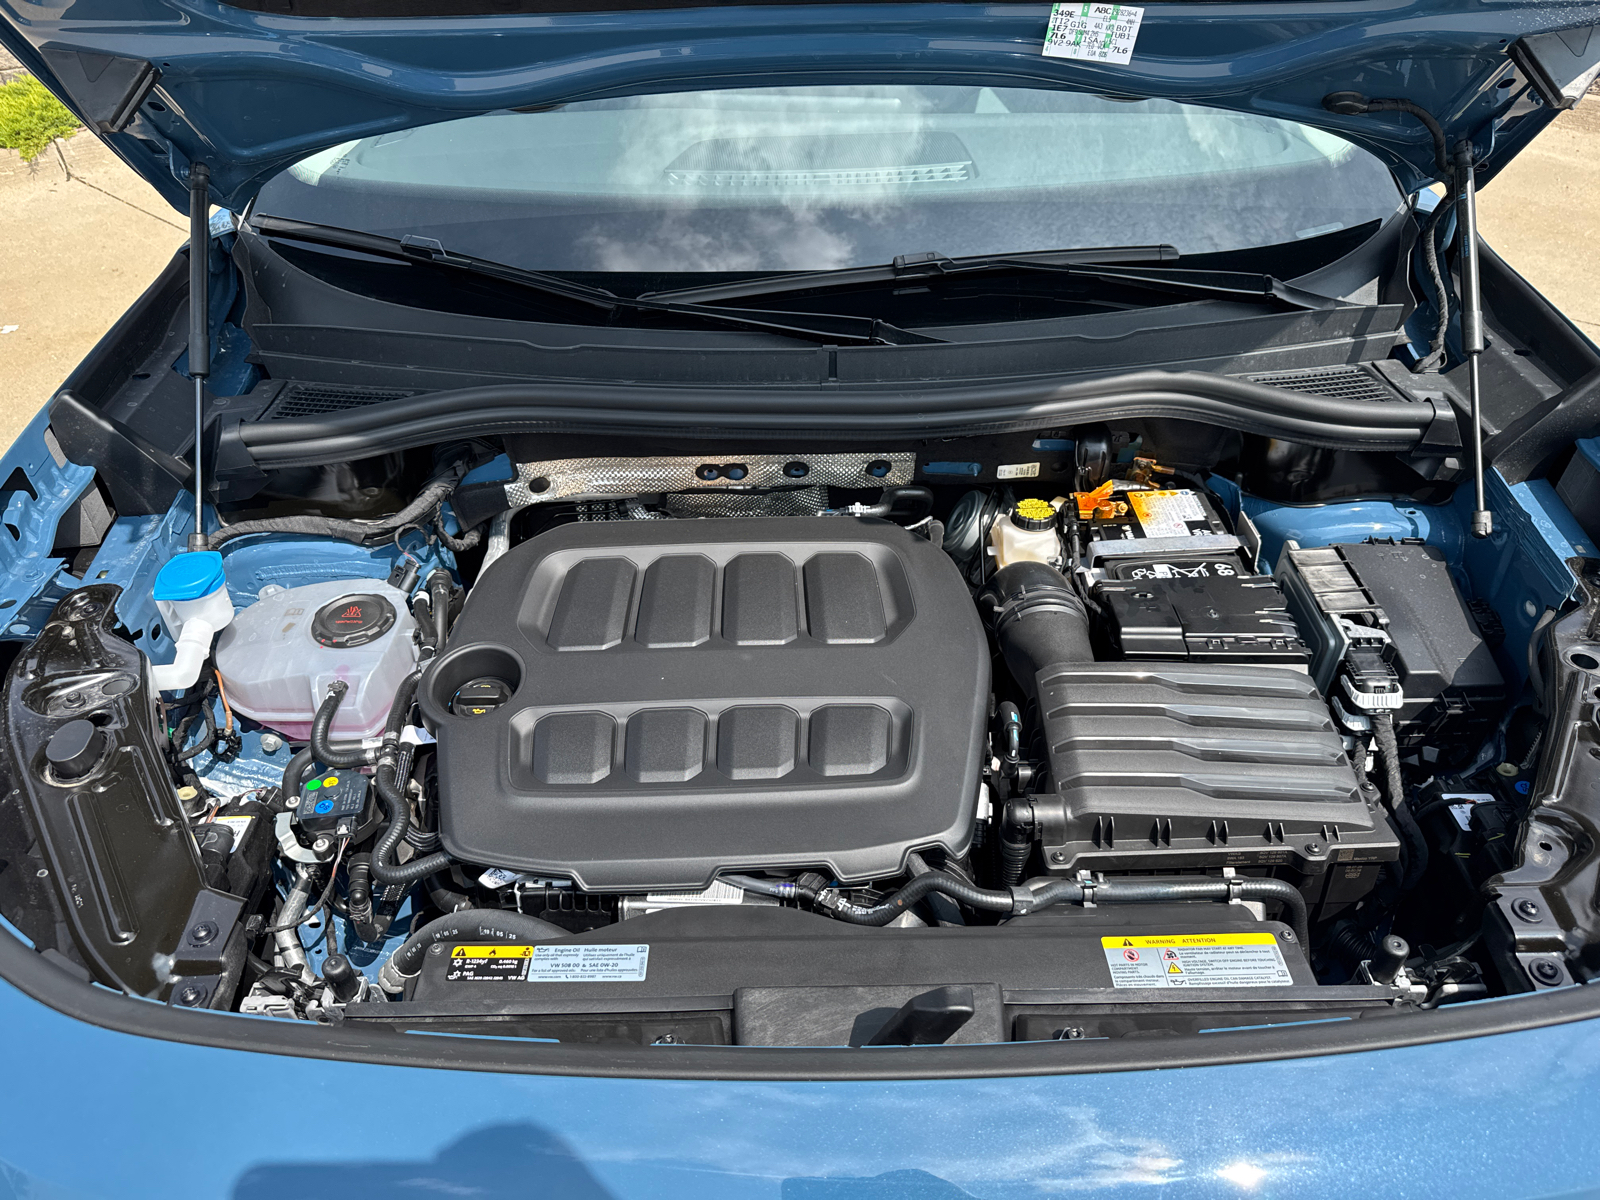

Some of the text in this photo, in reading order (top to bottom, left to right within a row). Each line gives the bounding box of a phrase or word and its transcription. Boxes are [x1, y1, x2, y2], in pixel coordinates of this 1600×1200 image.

[1053, 9, 1076, 18] 349E
[1094, 6, 1112, 15] ABC
[1070, 20, 1087, 29] G1G
[1050, 32, 1066, 40] 7L6
[1112, 46, 1128, 54] 7L6
